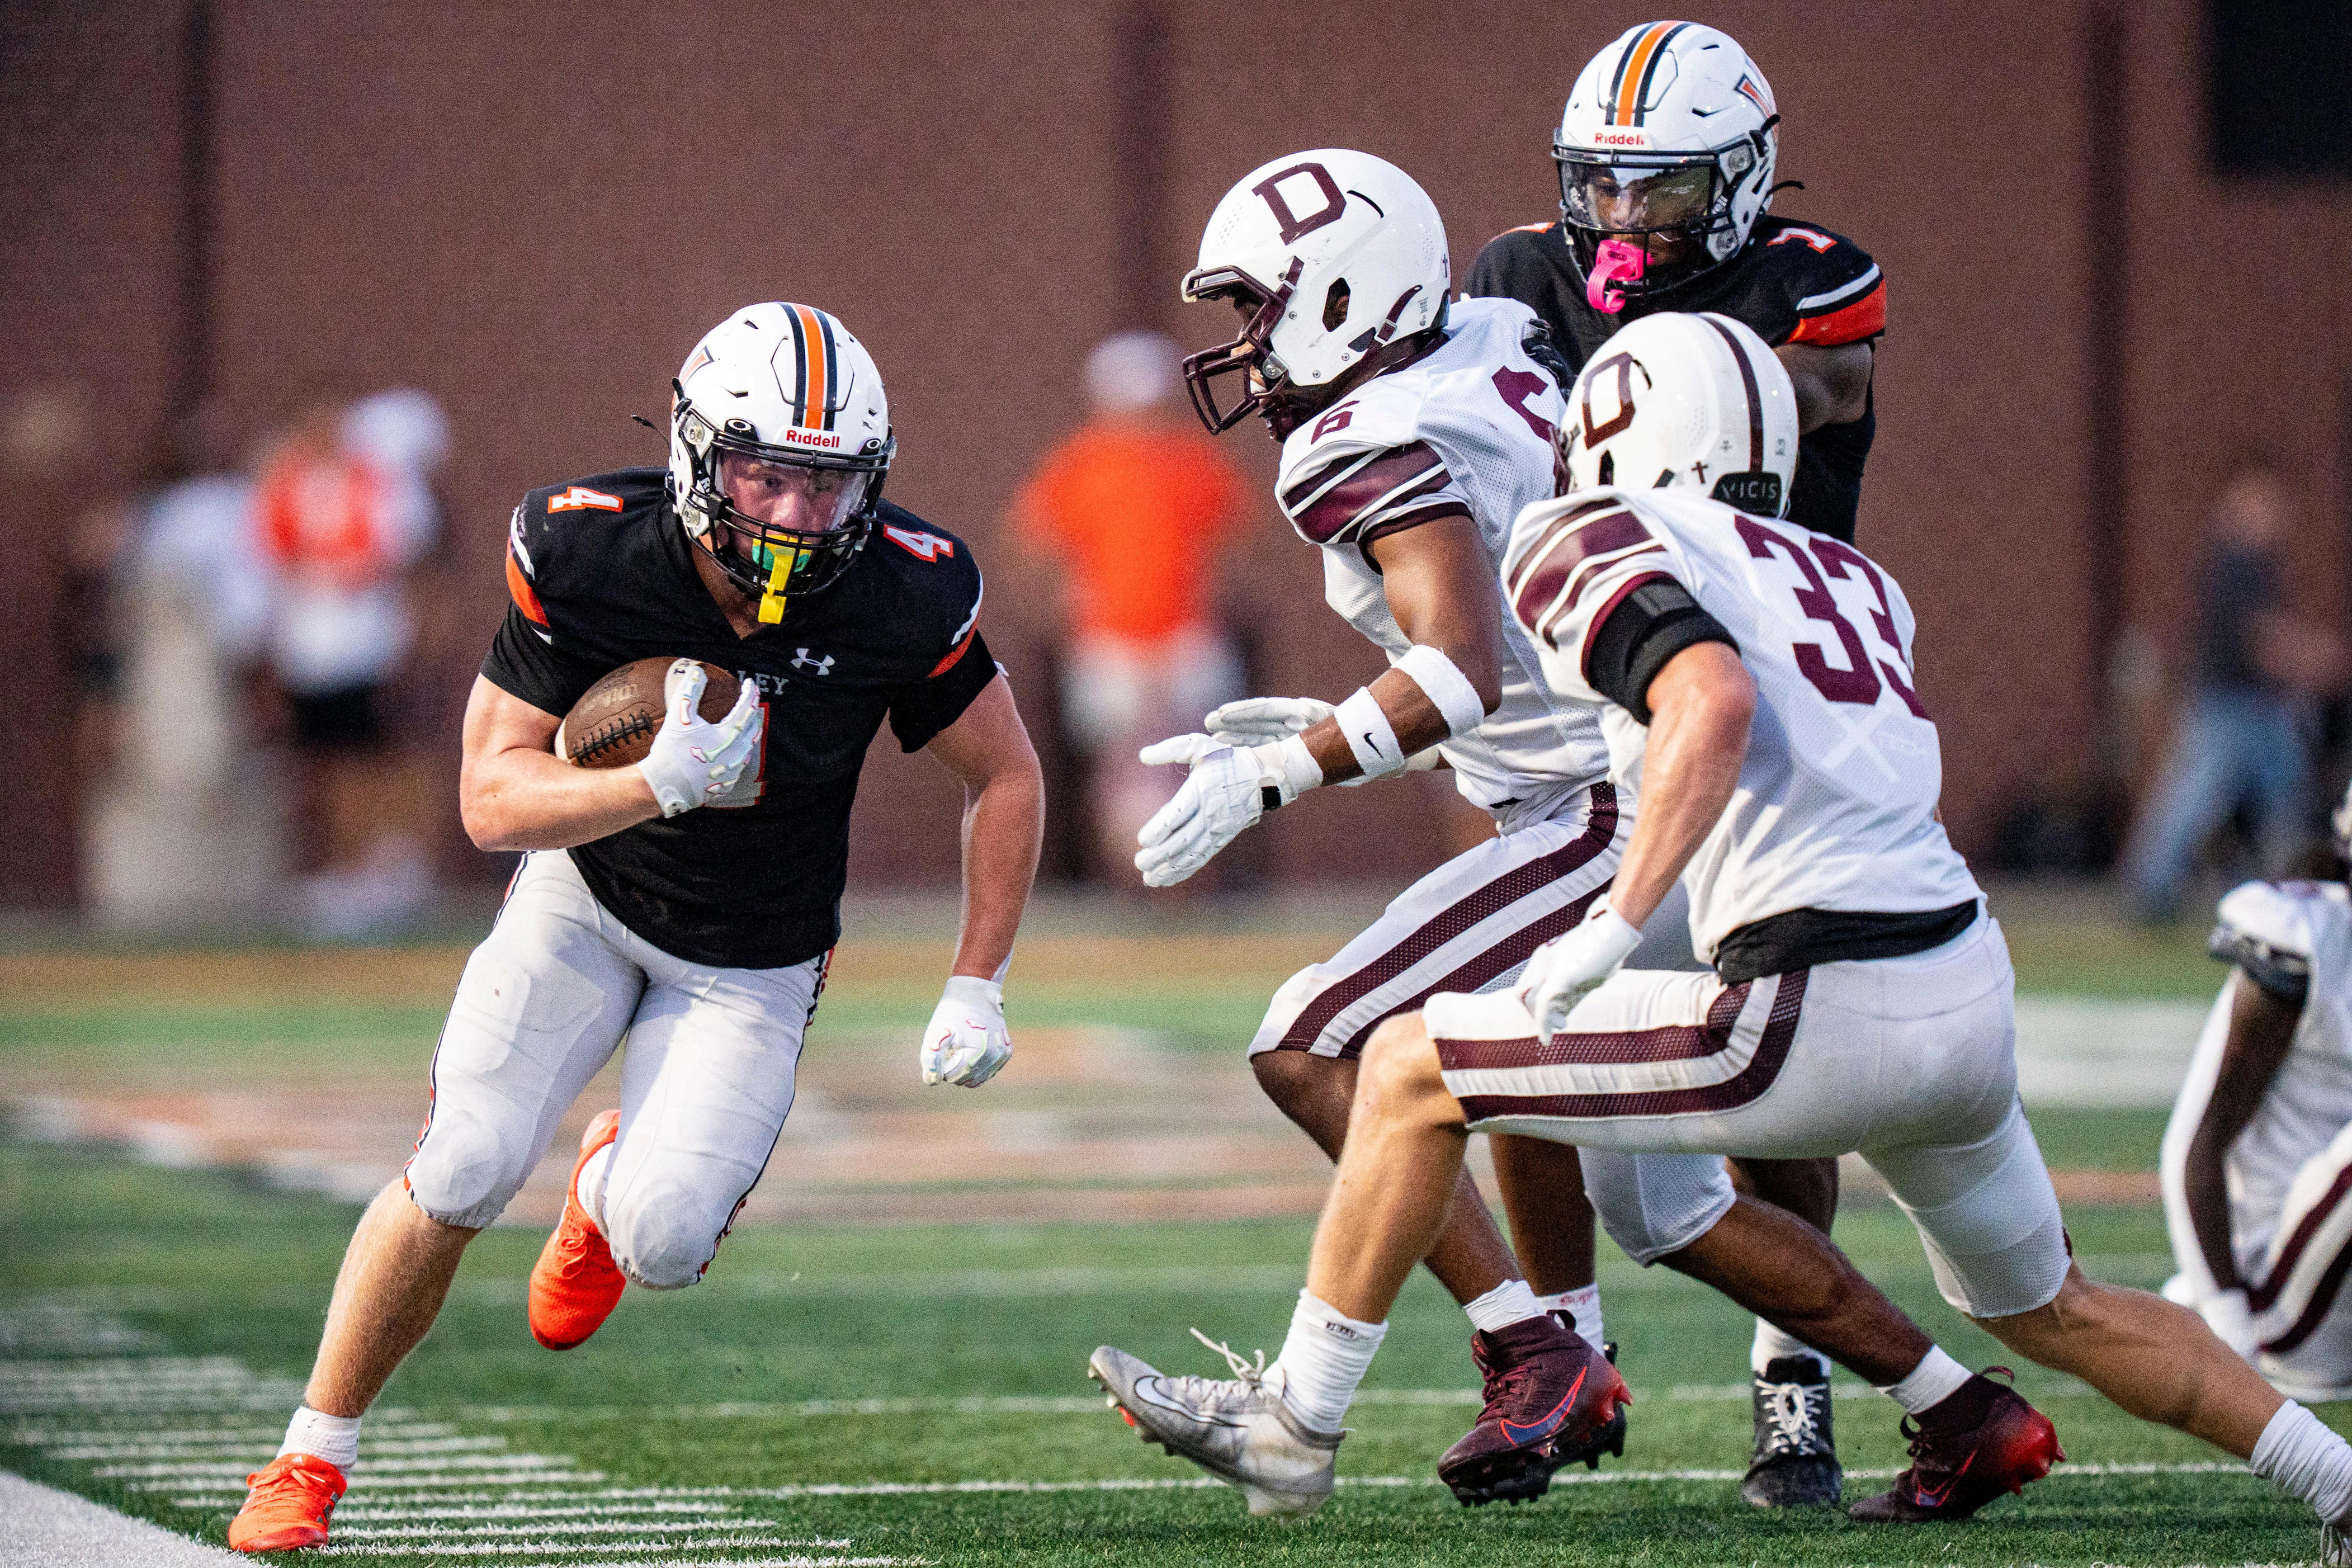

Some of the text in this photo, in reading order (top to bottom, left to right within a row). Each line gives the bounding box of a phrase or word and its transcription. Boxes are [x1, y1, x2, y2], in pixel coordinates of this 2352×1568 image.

[1595, 133, 1645, 145] Riddell
[1251, 162, 1347, 246] D
[1582, 352, 1636, 451] D
[786, 429, 840, 448] Riddell
[1311, 400, 1360, 445] 6
[547, 486, 624, 514] 4
[1721, 480, 1778, 499] VICIS
[883, 524, 953, 563] 4
[1734, 514, 1930, 721] 33
